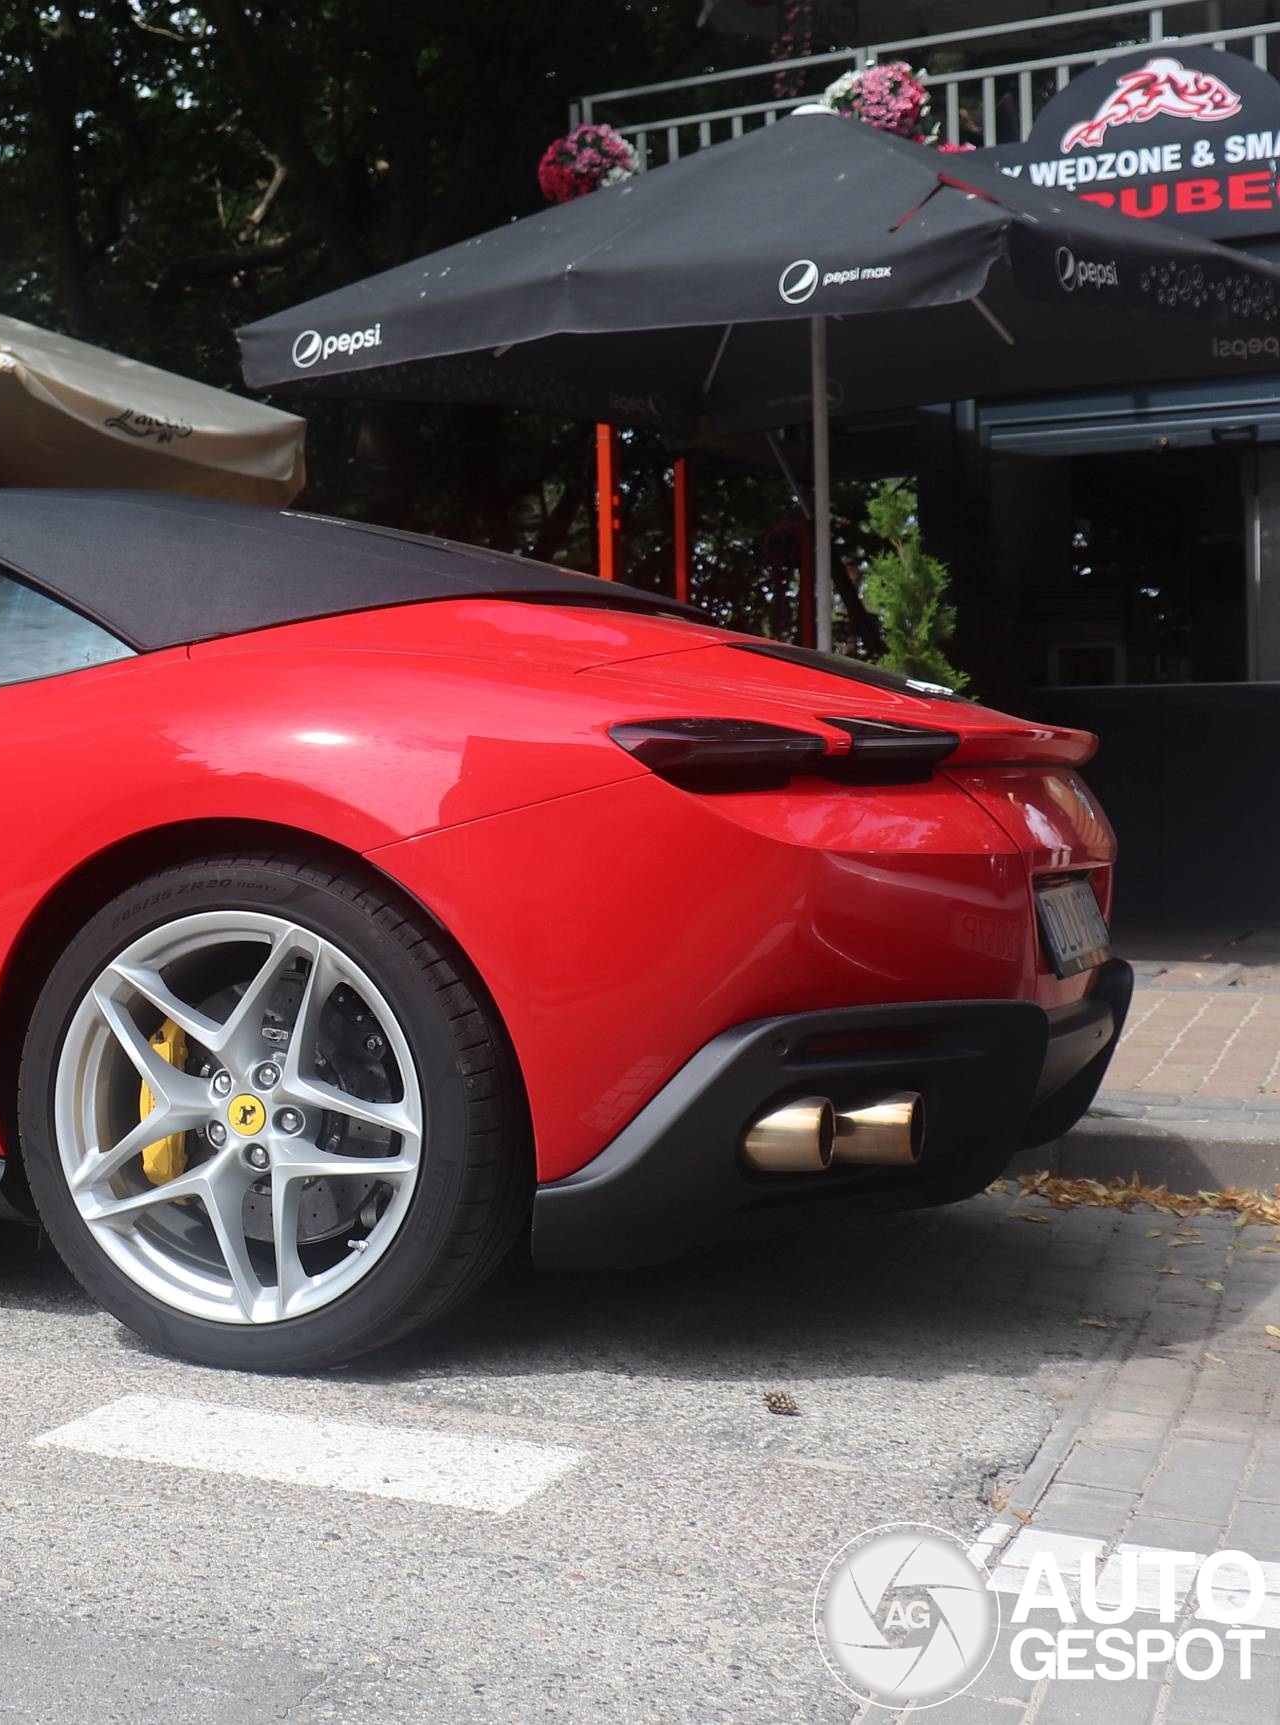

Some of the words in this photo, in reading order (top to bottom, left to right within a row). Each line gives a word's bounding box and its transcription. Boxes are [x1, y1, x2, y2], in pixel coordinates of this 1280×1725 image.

[1029, 143, 1182, 192] WĘDZONE
[1190, 139, 1216, 168] &
[1077, 171, 1280, 219] UBE
[821, 267, 860, 287] pepsi
[860, 265, 892, 281] max
[1077, 260, 1119, 289] pepsi
[322, 323, 382, 361] pepsi
[176, 878, 233, 896] ZR20
